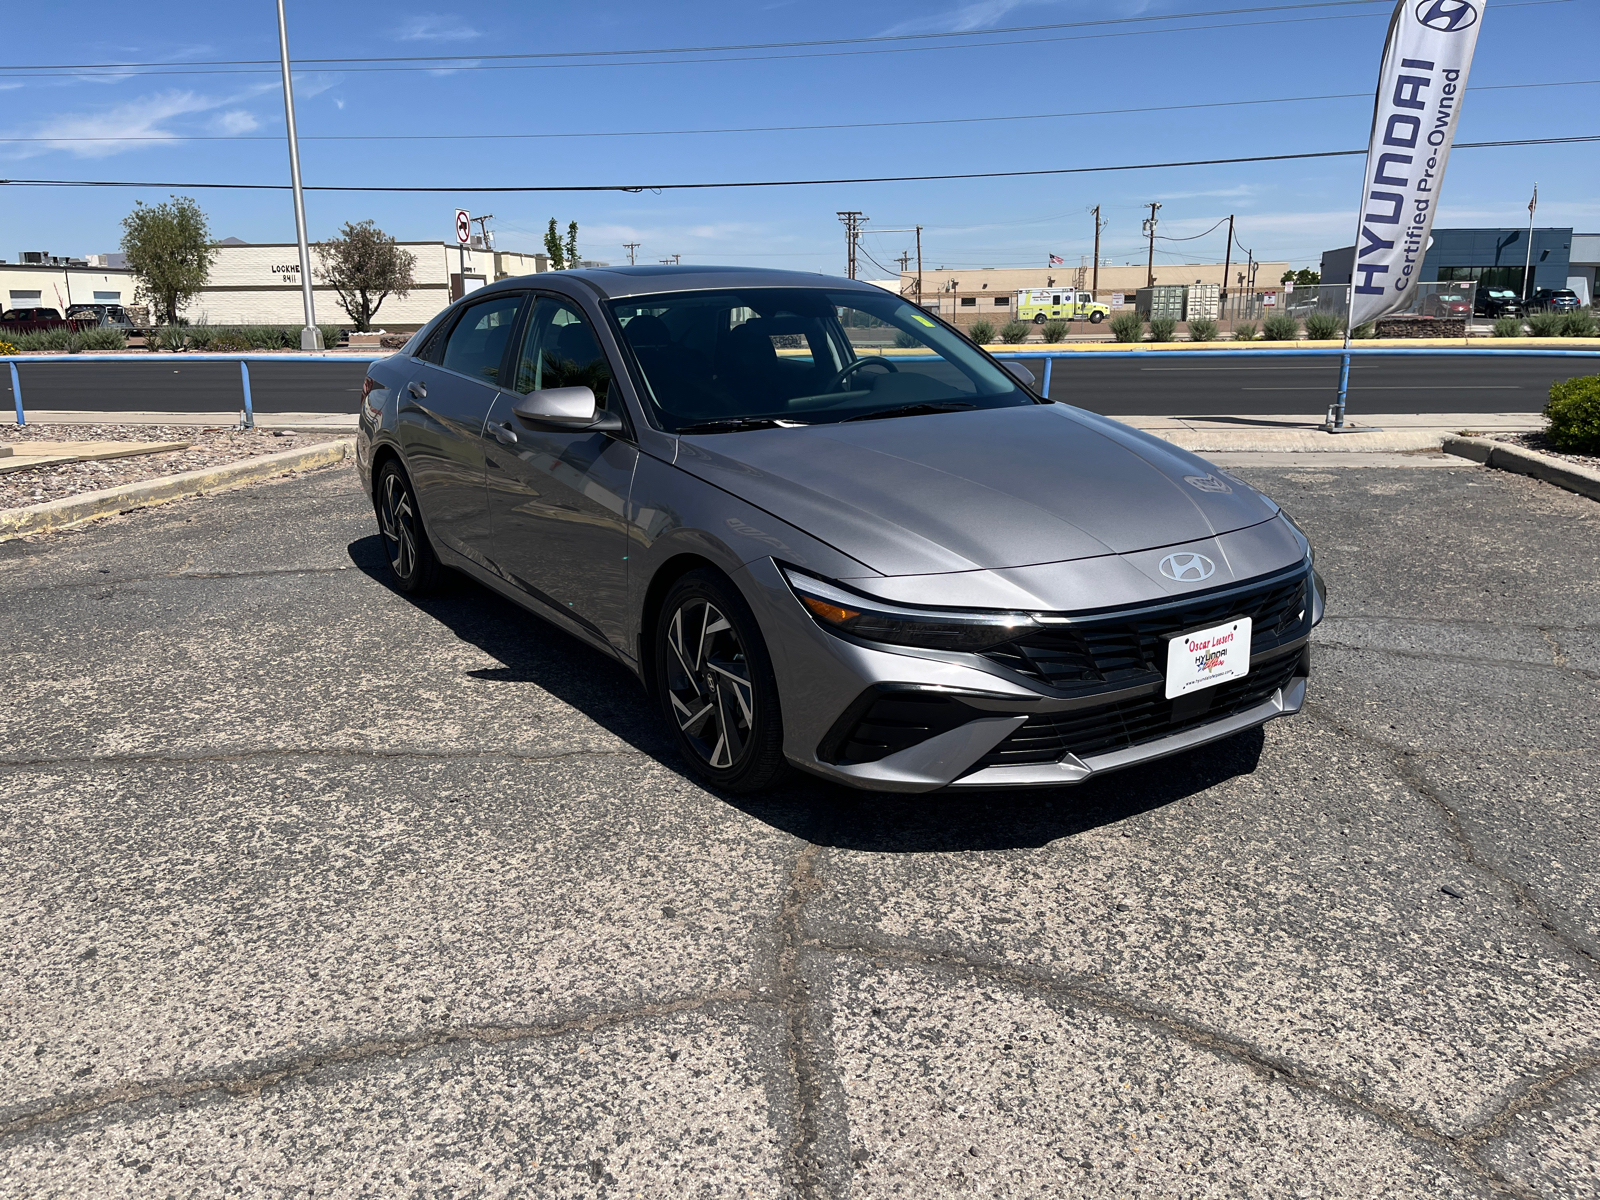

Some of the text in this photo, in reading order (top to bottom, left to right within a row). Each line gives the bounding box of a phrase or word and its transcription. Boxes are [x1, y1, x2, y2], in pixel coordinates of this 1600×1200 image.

[1354, 58, 1435, 296] HYUNDAI
[1395, 69, 1460, 291] Certified Pre-Owned
[271, 265, 301, 273] LOCKHE
[282, 274, 297, 283] 8411
[1189, 640, 1211, 653] Oscar
[1195, 648, 1228, 665] HYUNDAI
